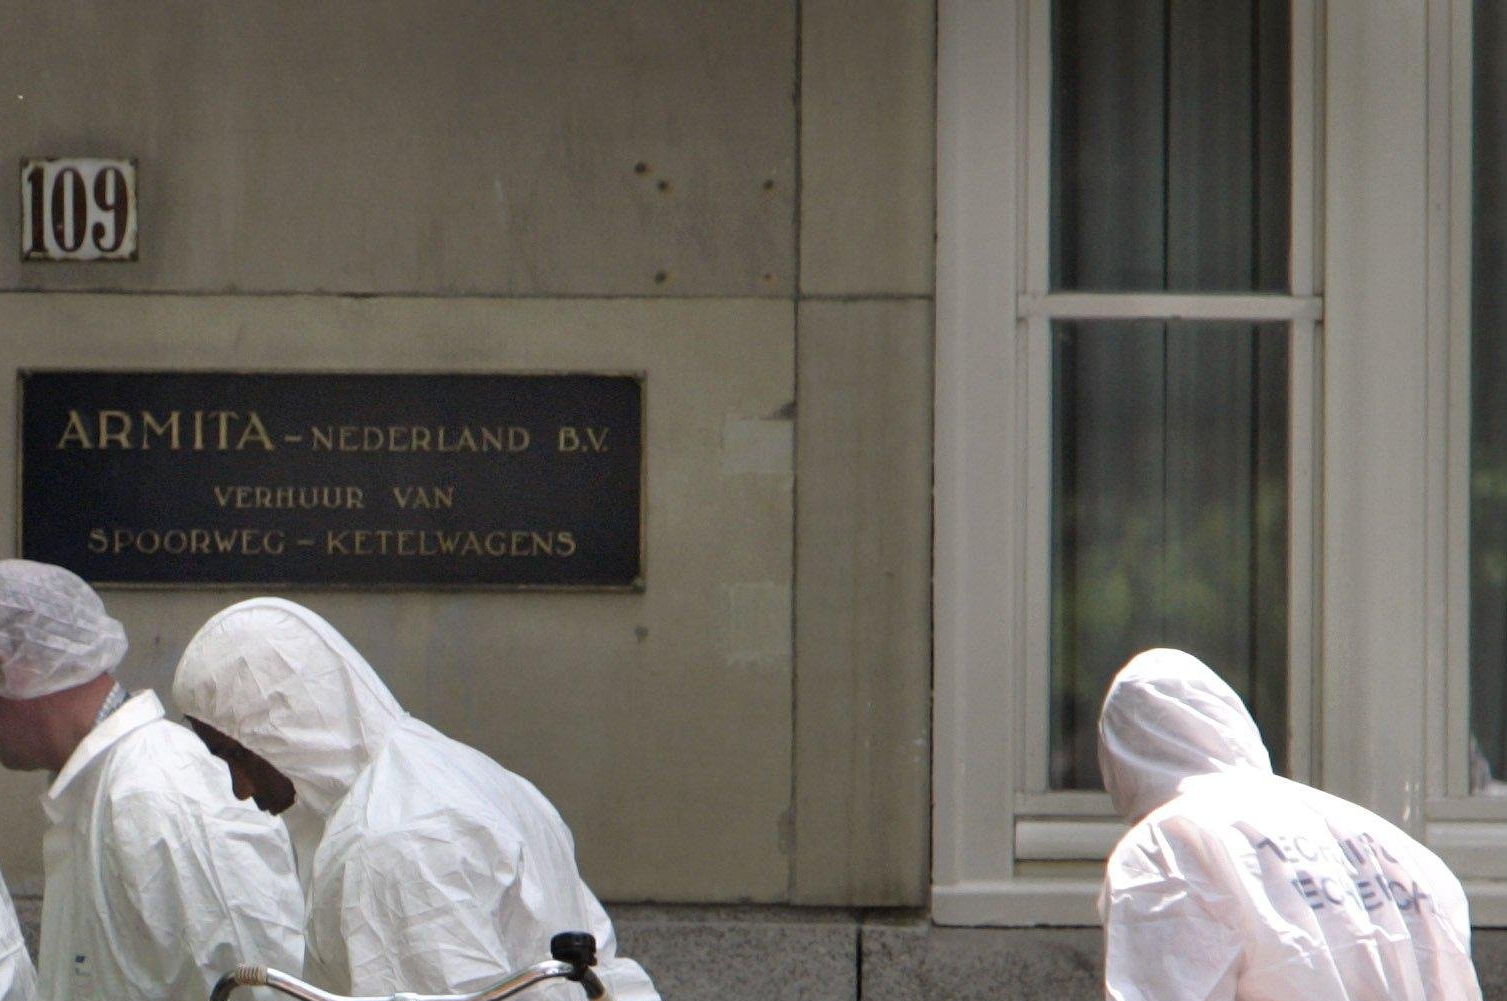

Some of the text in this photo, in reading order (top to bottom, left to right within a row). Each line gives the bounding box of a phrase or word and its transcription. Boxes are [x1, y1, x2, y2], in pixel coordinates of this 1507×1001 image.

[27, 166, 129, 252] 109
[558, 426, 610, 451] B.V.
[212, 485, 456, 509] VERHUUR VAN
